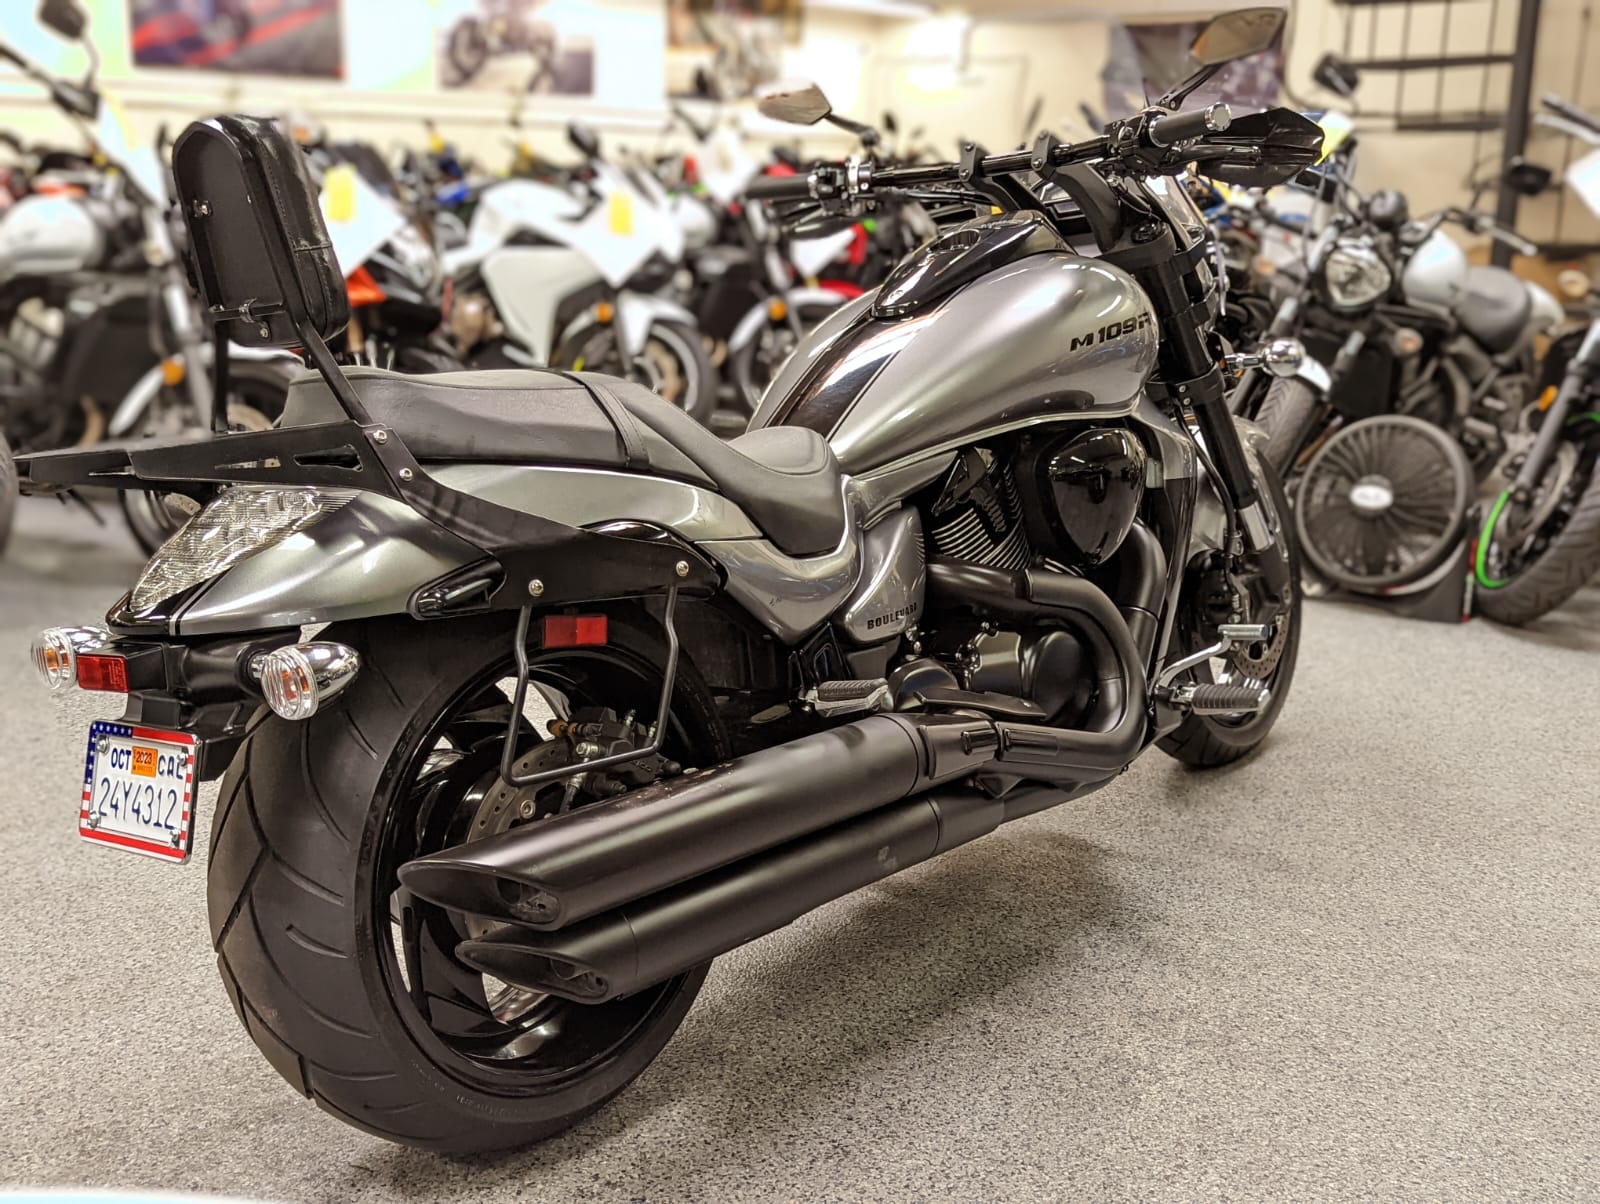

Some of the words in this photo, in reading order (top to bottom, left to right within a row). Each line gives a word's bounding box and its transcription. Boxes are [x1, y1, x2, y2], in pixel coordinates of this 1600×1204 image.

[111, 748, 132, 770] OCT
[136, 751, 153, 765] 2023
[158, 755, 183, 780] CAL
[98, 777, 177, 830] 24Y4312
